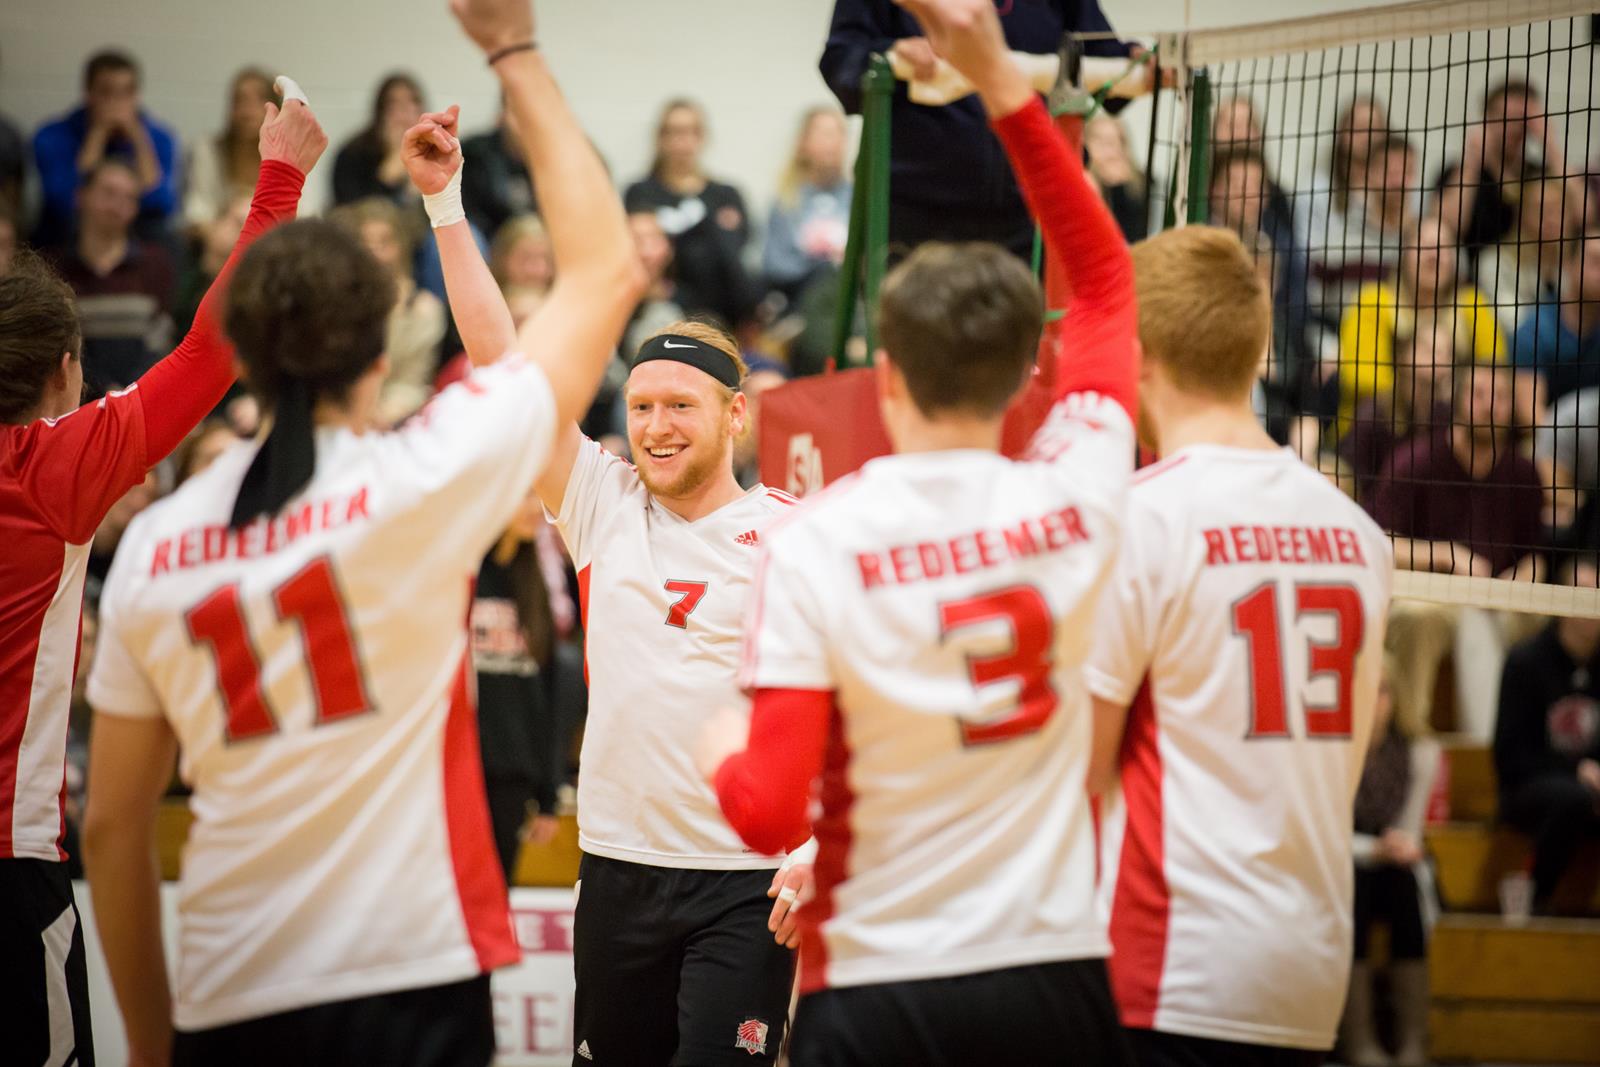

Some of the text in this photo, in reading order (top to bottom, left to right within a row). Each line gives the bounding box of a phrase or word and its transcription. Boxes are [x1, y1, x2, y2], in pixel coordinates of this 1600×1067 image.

[150, 485, 371, 579] REDEEMER
[856, 504, 1091, 591] REDEEMER
[184, 554, 379, 746] 11
[663, 577, 709, 630] 7
[937, 580, 1060, 749] 3
[1231, 578, 1366, 742] 13
